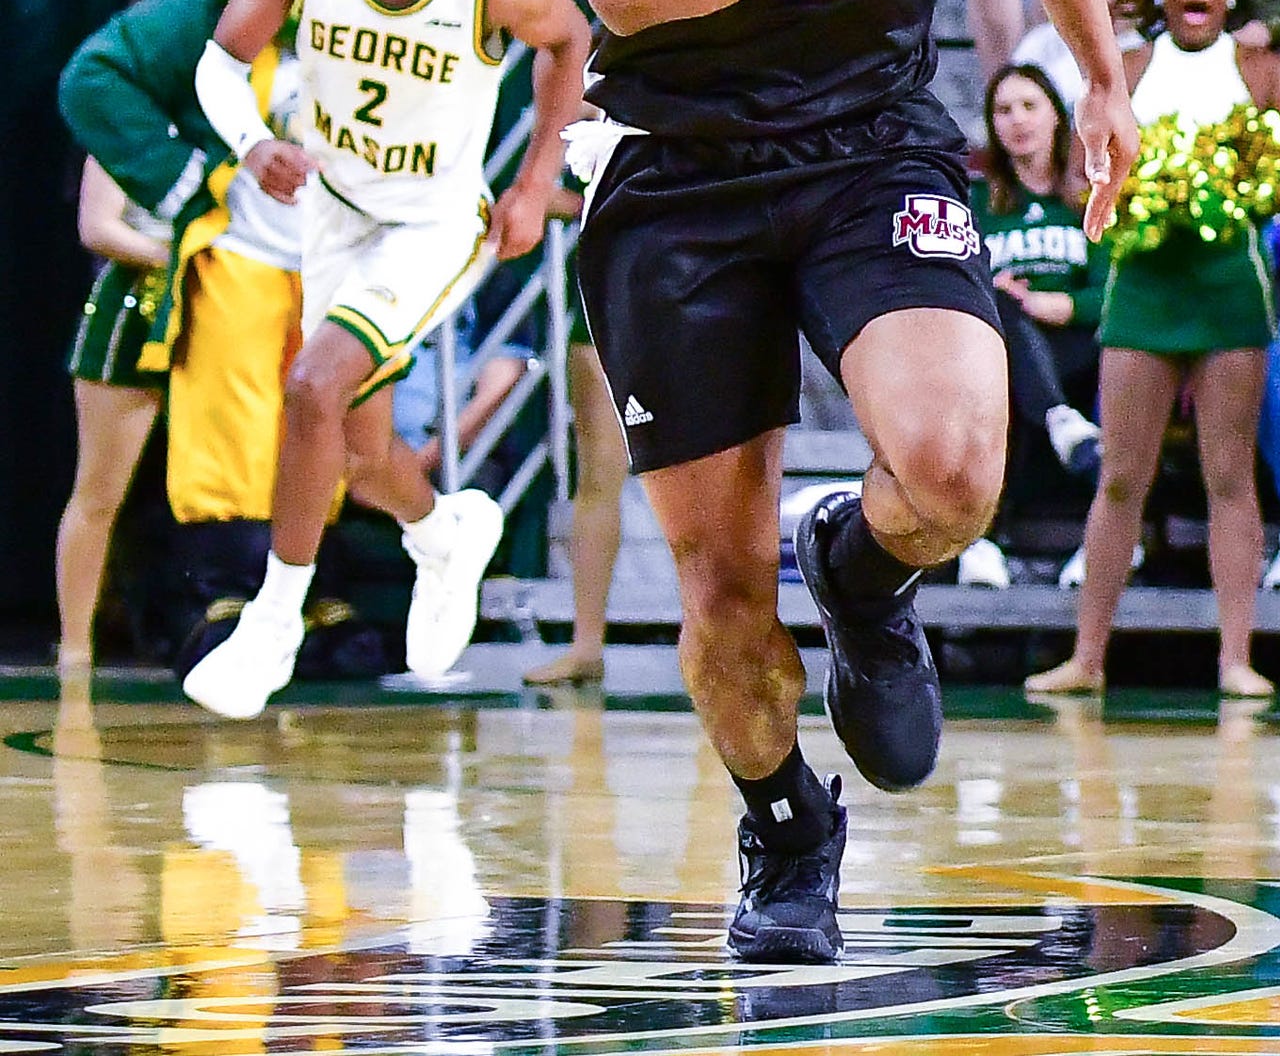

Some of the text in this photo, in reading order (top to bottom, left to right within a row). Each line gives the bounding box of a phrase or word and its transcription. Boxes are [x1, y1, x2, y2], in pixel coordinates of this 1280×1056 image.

[309, 19, 460, 84] GEORGE
[353, 76, 389, 128] 2
[314, 97, 438, 178] MASON
